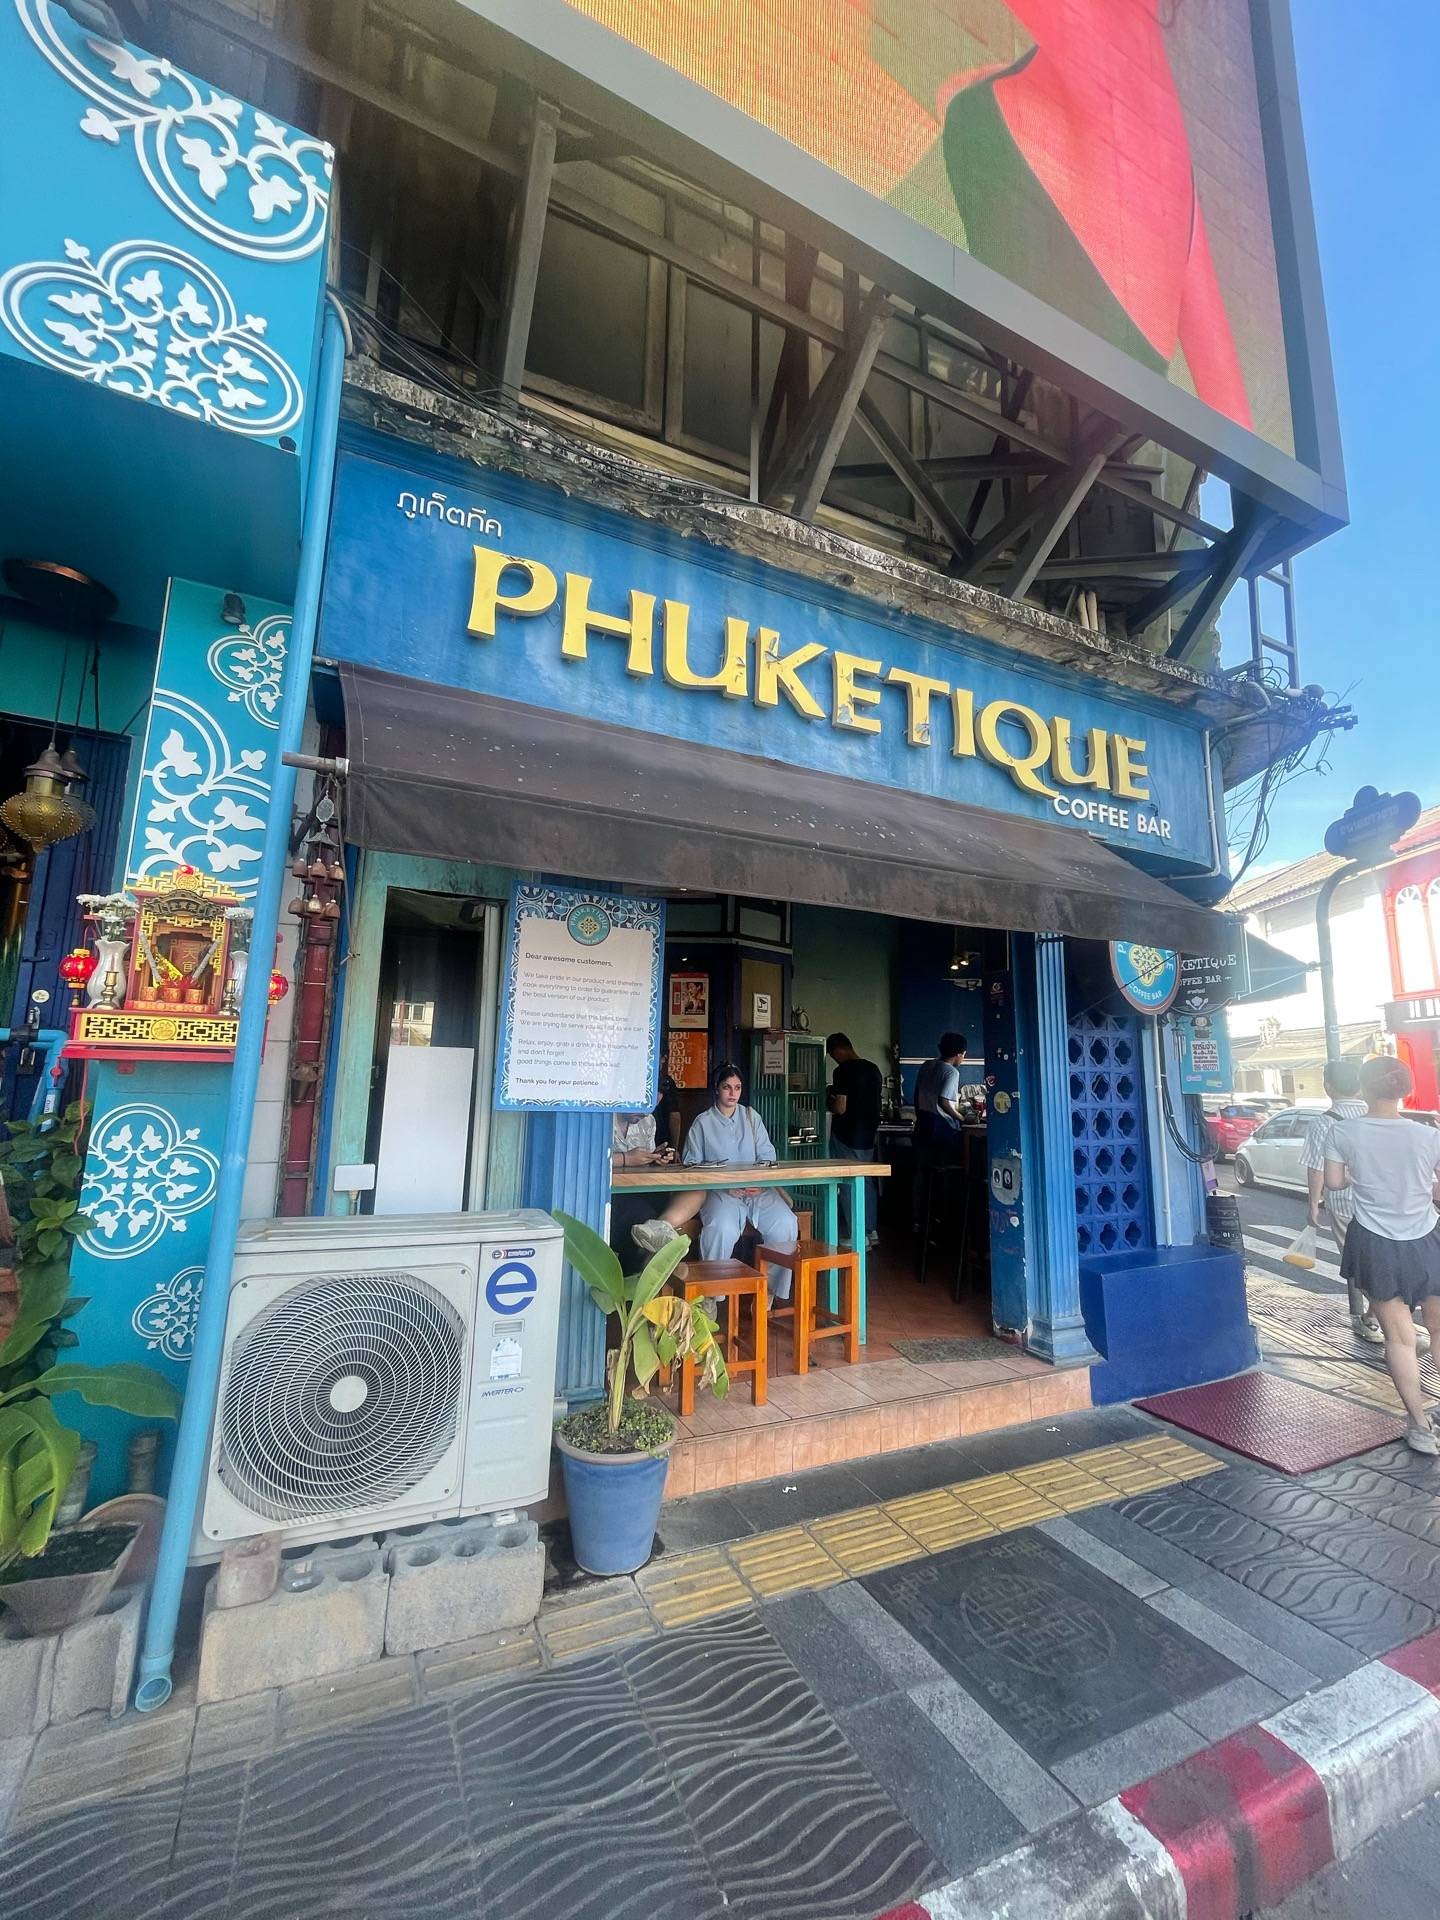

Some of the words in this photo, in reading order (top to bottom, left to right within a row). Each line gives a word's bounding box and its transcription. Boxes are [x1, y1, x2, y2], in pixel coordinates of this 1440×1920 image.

[397, 491, 502, 537] ภูเก็ตทีค
[467, 545, 1151, 801] PHUKETIQUE
[1053, 795, 1129, 829] COFFEE
[1136, 812, 1172, 839] BAR
[577, 958, 613, 967] customers,
[1129, 982, 1150, 1000] COFFEE
[1151, 990, 1162, 1000] BAR
[1180, 976, 1203, 986] FFEE
[1205, 974, 1222, 984] BAR
